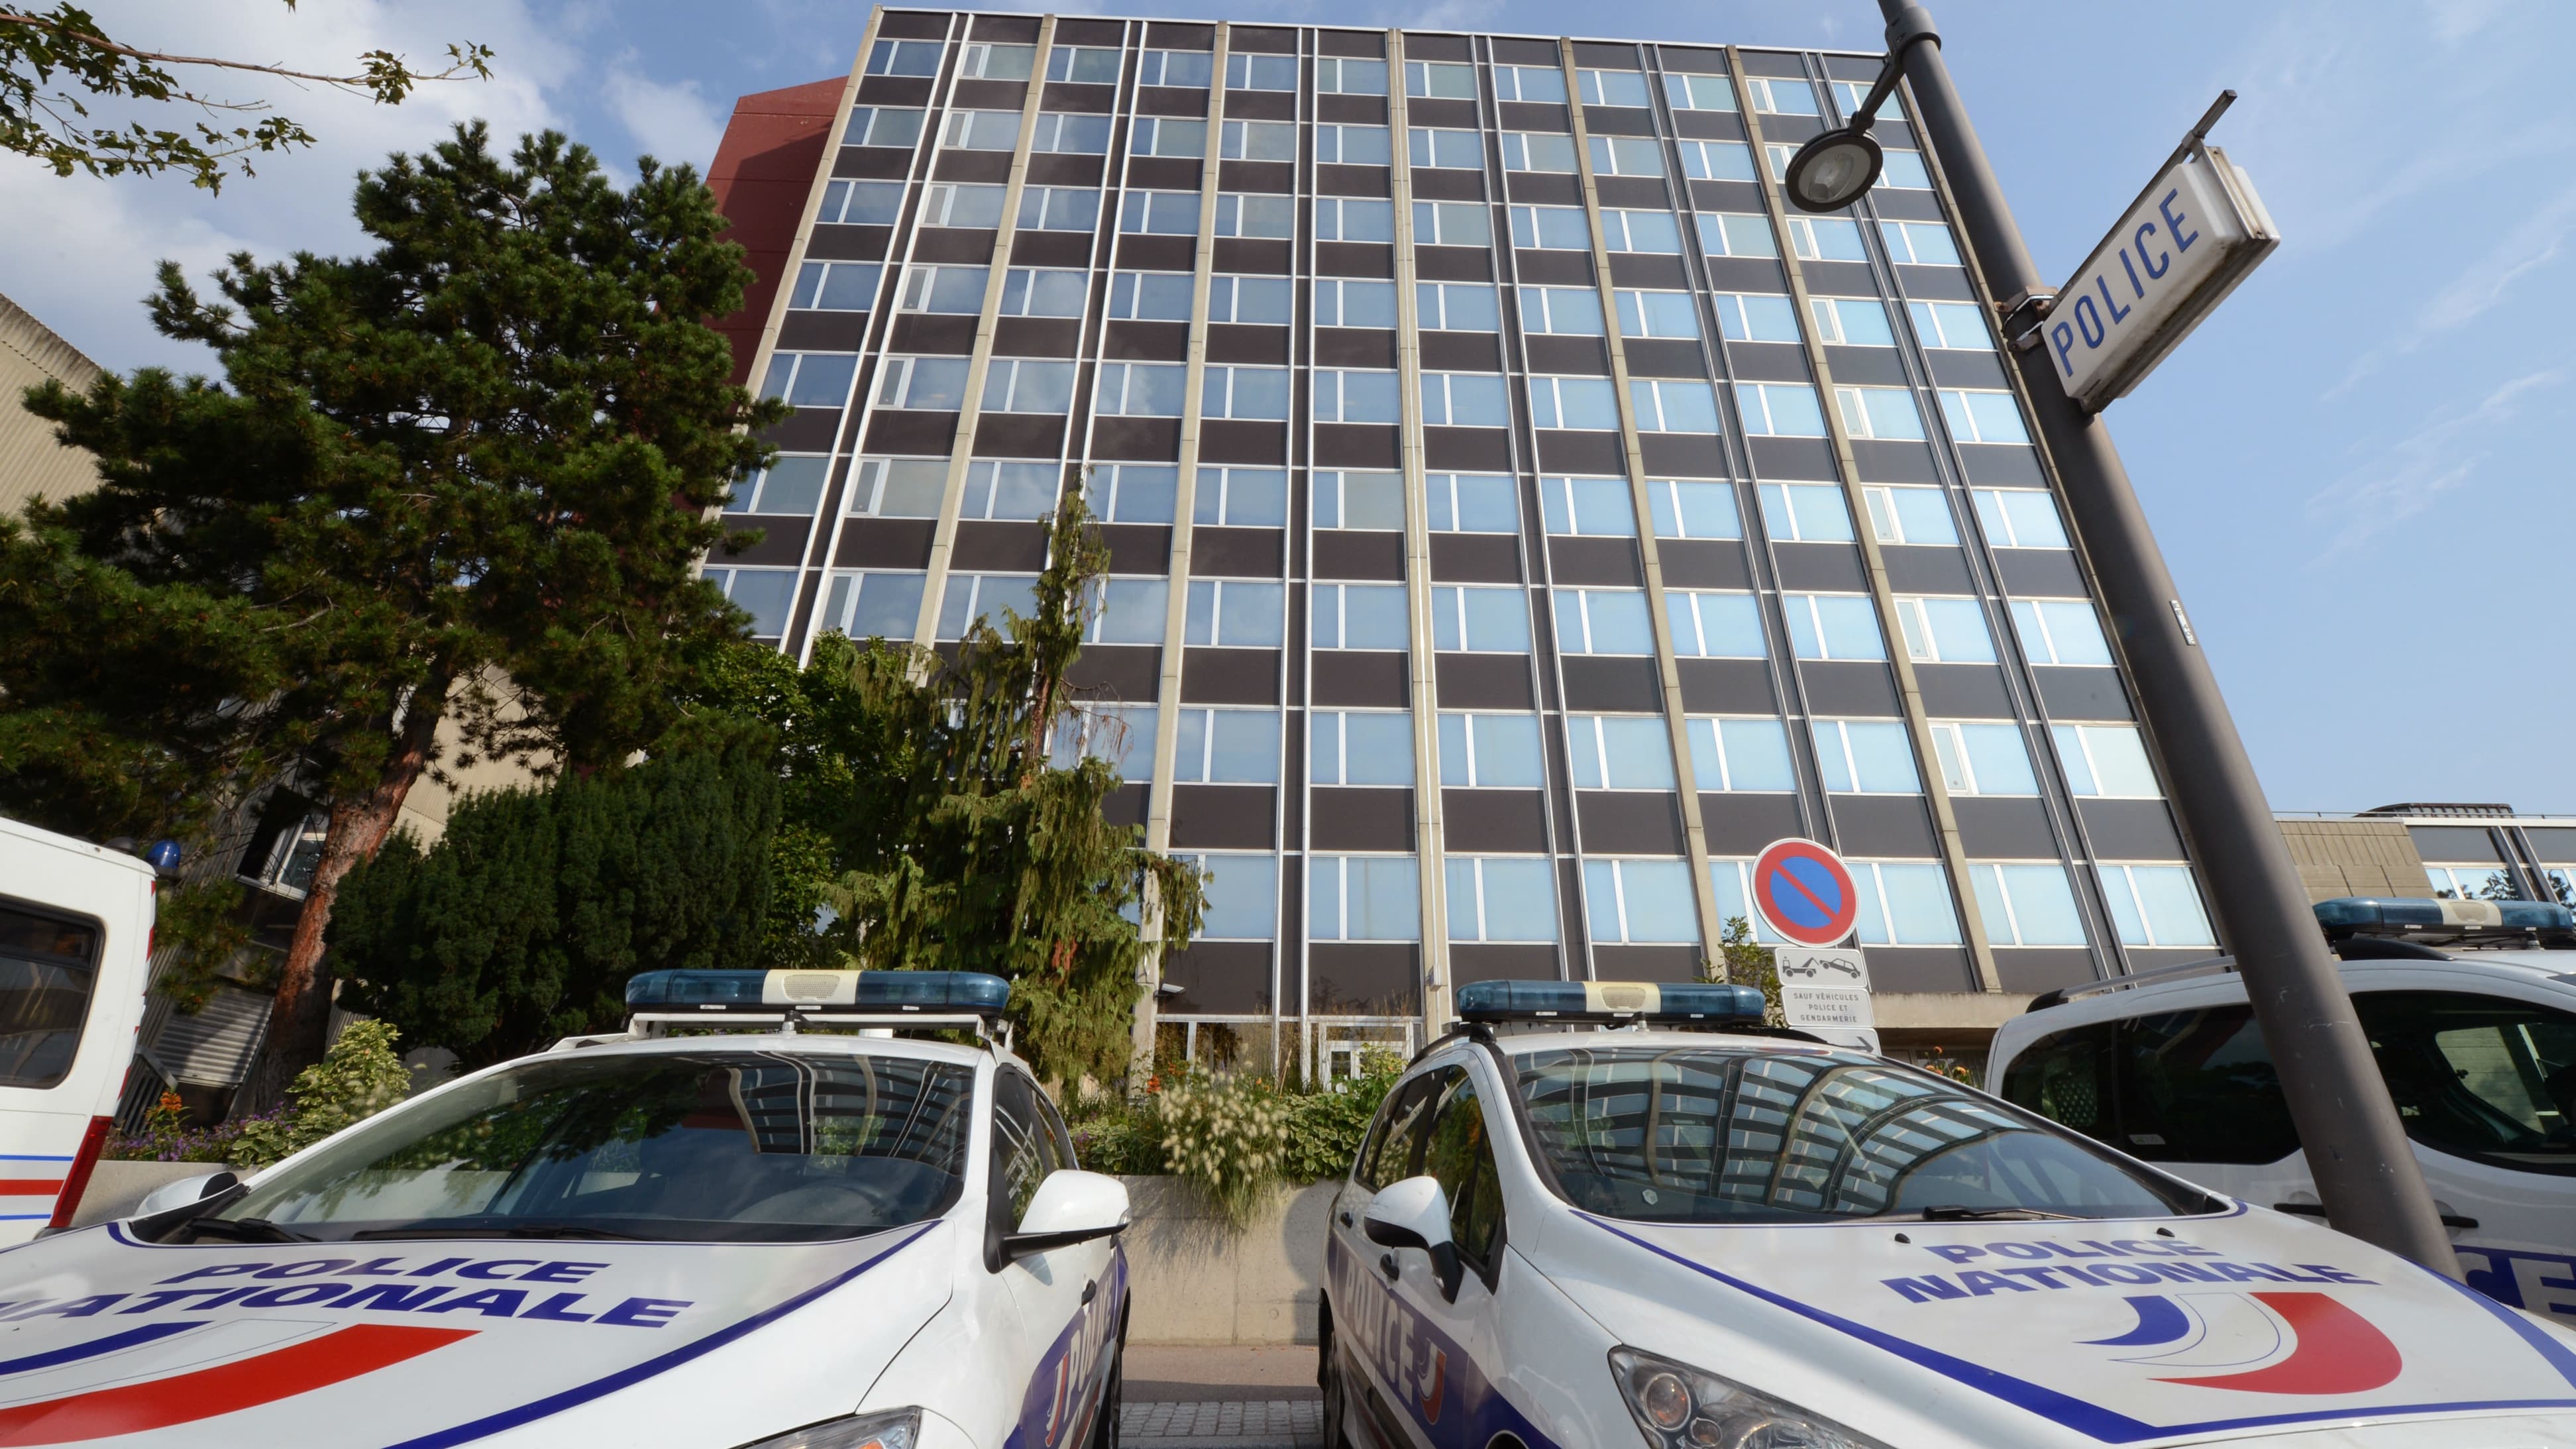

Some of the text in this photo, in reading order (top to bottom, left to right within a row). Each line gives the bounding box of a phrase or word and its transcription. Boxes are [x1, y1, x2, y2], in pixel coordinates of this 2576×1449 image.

[2051, 188, 2199, 378] POLICE
[1808, 1003, 1837, 1012] POLICE
[1815, 993, 1859, 1001] VÉHICULES
[1800, 1014, 1858, 1023] GENDARMERIE
[1923, 1240, 2224, 1264] POLICE
[150, 1257, 611, 1285] POLICE
[1880, 1261, 2384, 1304] NATIONALE
[1344, 1256, 1415, 1406] POLICE
[1063, 1271, 1113, 1424] POLICE
